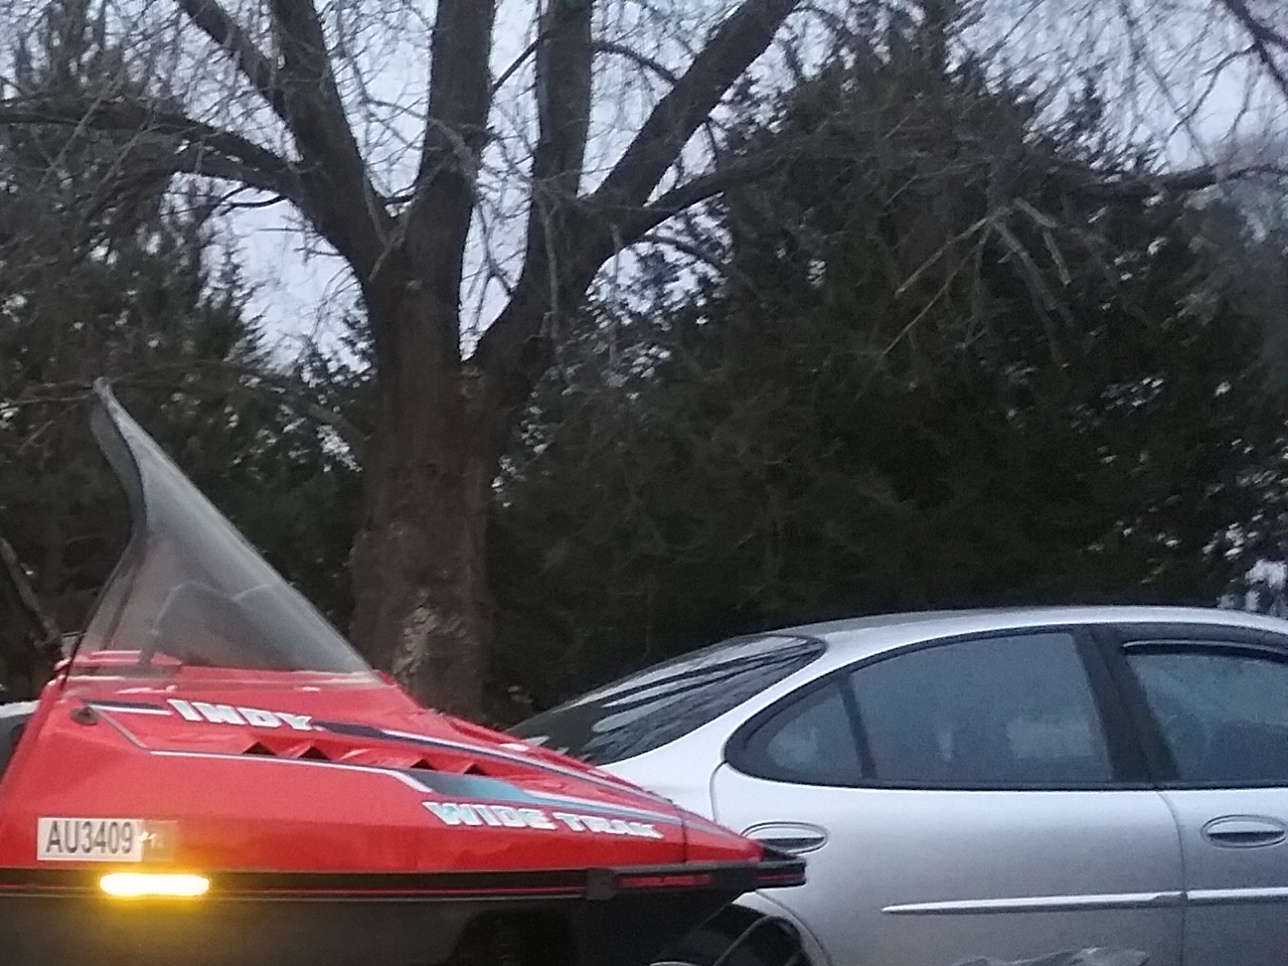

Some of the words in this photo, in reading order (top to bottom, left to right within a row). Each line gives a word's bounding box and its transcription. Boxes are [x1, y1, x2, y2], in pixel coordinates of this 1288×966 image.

[166, 698, 314, 732] INDY
[44, 819, 134, 855] AU3409
[421, 801, 558, 831] WIDE
[552, 811, 664, 839] TRAK
